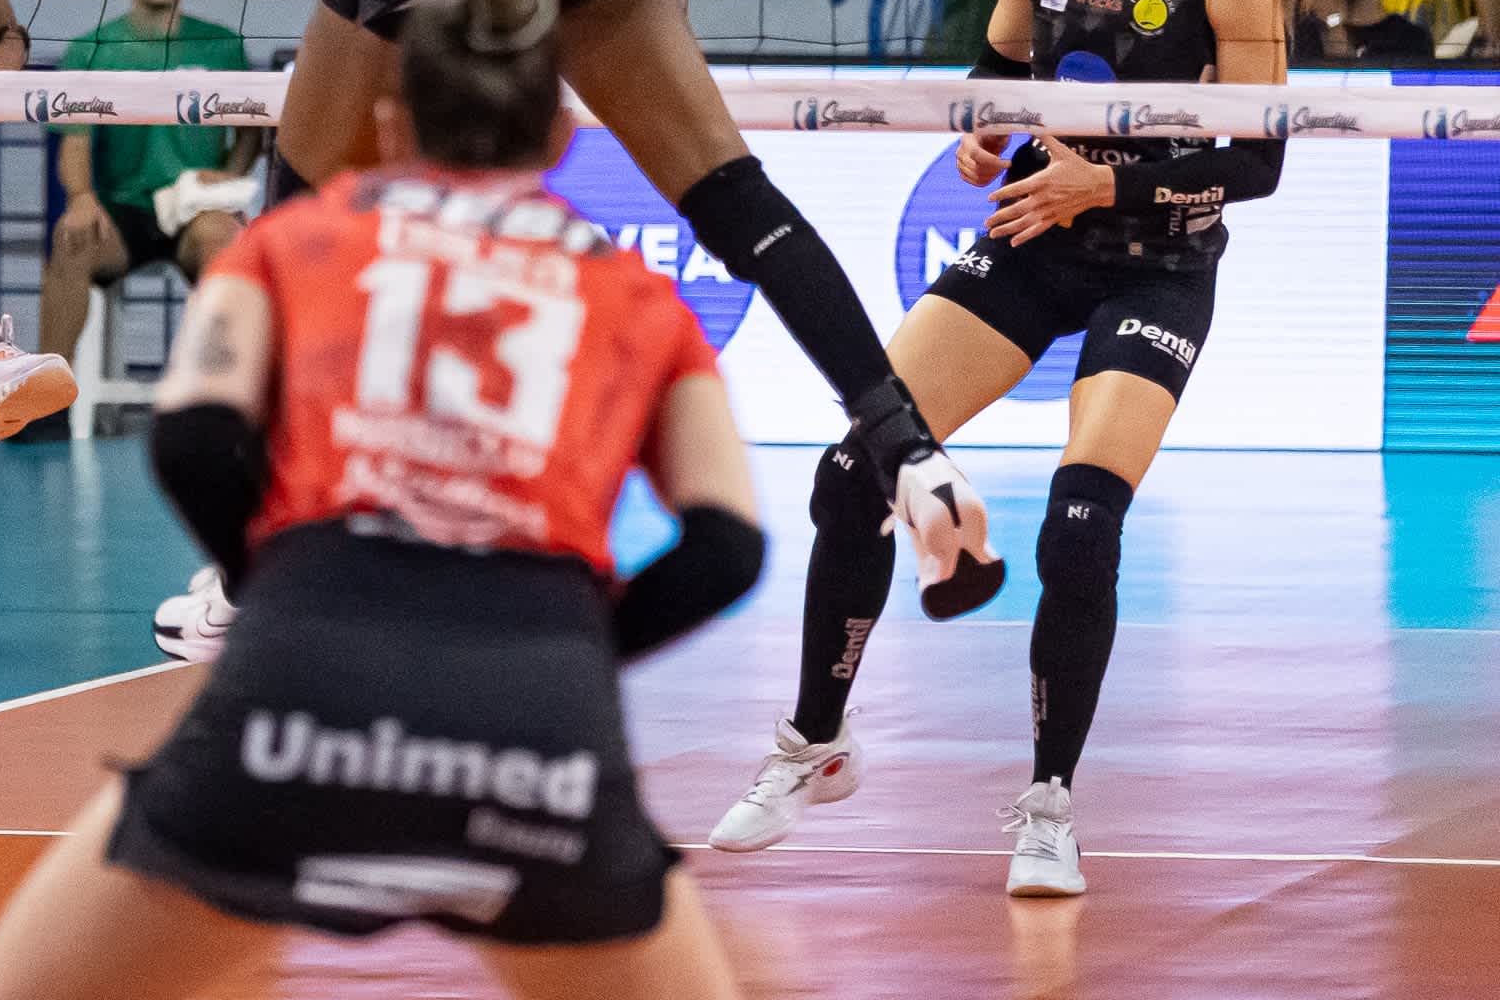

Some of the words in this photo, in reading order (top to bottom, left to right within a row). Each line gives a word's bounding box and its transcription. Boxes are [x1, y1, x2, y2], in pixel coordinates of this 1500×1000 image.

[51, 91, 118, 117] Superliga
[202, 90, 270, 117] Superliga
[1153, 186, 1226, 204] Dentil
[357, 260, 586, 452] 13
[1116, 318, 1197, 364] Dentil
[240, 708, 598, 820] Unimed
